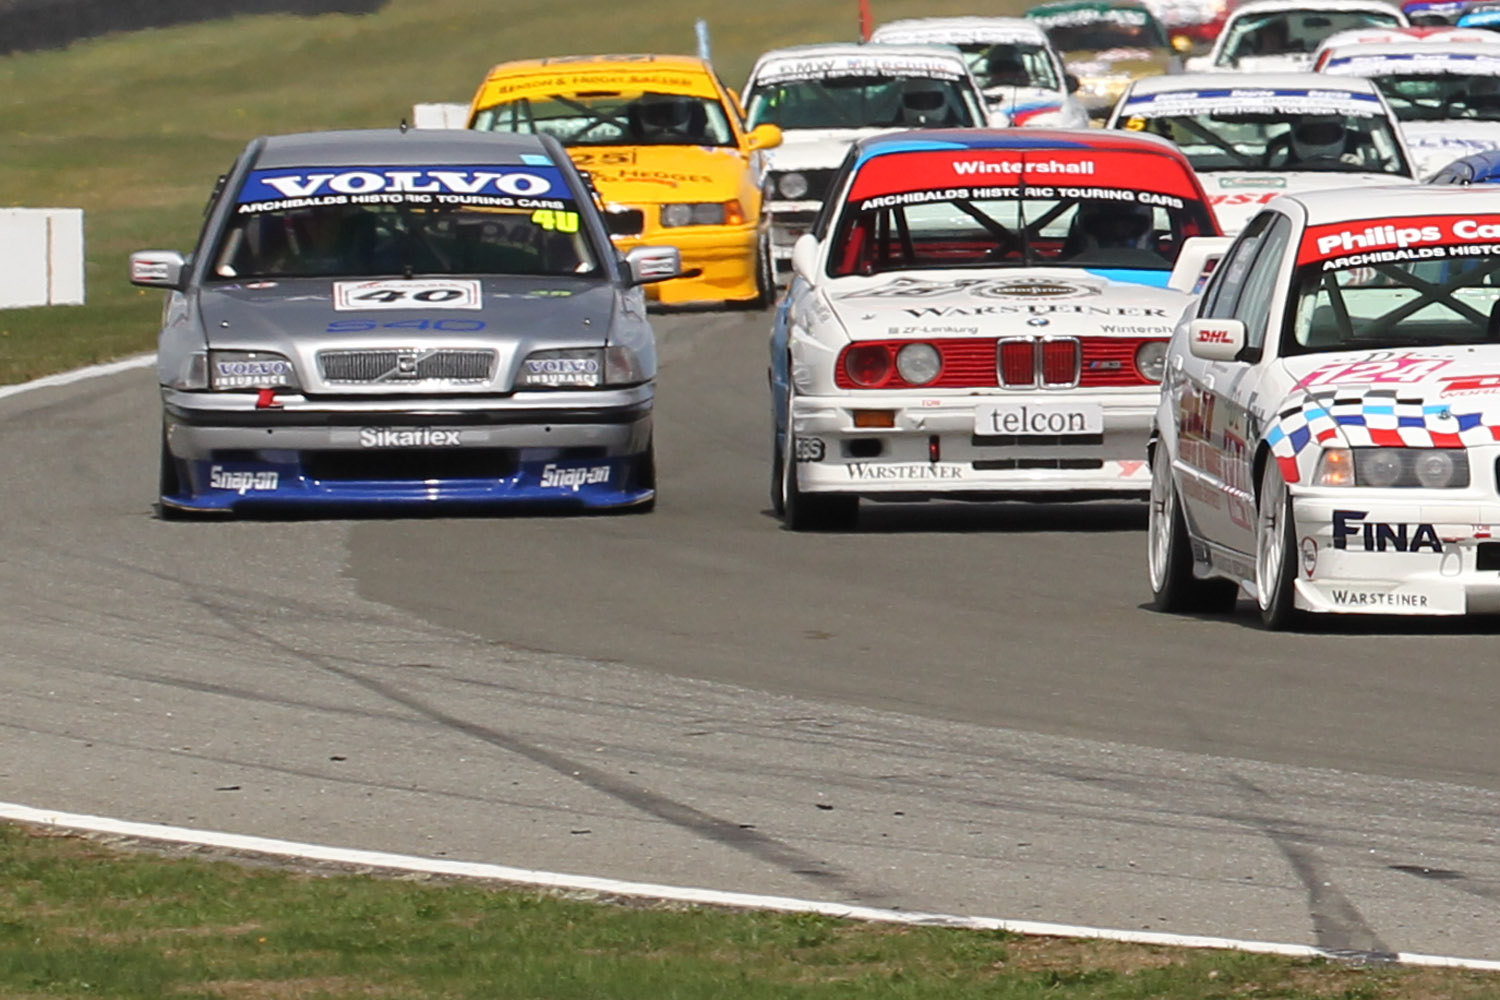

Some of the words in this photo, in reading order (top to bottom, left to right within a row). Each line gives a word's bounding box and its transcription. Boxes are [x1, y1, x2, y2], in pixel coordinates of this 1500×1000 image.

[952, 158, 1095, 176] Wintershall
[261, 171, 551, 198] VOLVO
[238, 195, 348, 214] ARCHIBALDS
[351, 193, 432, 204] HISTORIC
[436, 194, 514, 208] TOURING
[517, 199, 565, 210] CARS
[861, 188, 969, 211] ARCHIBALDS
[972, 185, 1055, 199] HISTORIC
[1059, 186, 1135, 202] TOURING
[1138, 192, 1184, 209] CARS
[1317, 223, 1441, 255] Philips
[1322, 246, 1447, 271] ARCHIBALDS
[349, 288, 464, 304] 40
[905, 304, 1169, 319] WARSTEINER
[1099, 323, 1173, 336] Wintersh
[1195, 330, 1234, 344] DHL
[216, 360, 289, 376] VOLVO
[526, 358, 599, 374] VOLVO
[215, 375, 287, 387] INSURANCE
[526, 374, 599, 387] INSURANCE
[991, 406, 1086, 433] telcon
[359, 426, 461, 448] Sikaflex
[210, 466, 279, 494] Snap-on
[540, 463, 612, 492] Snap-on
[845, 462, 963, 480] WARSTEINER
[1333, 509, 1444, 553] FINA
[1332, 589, 1428, 607] WARSTEINER
